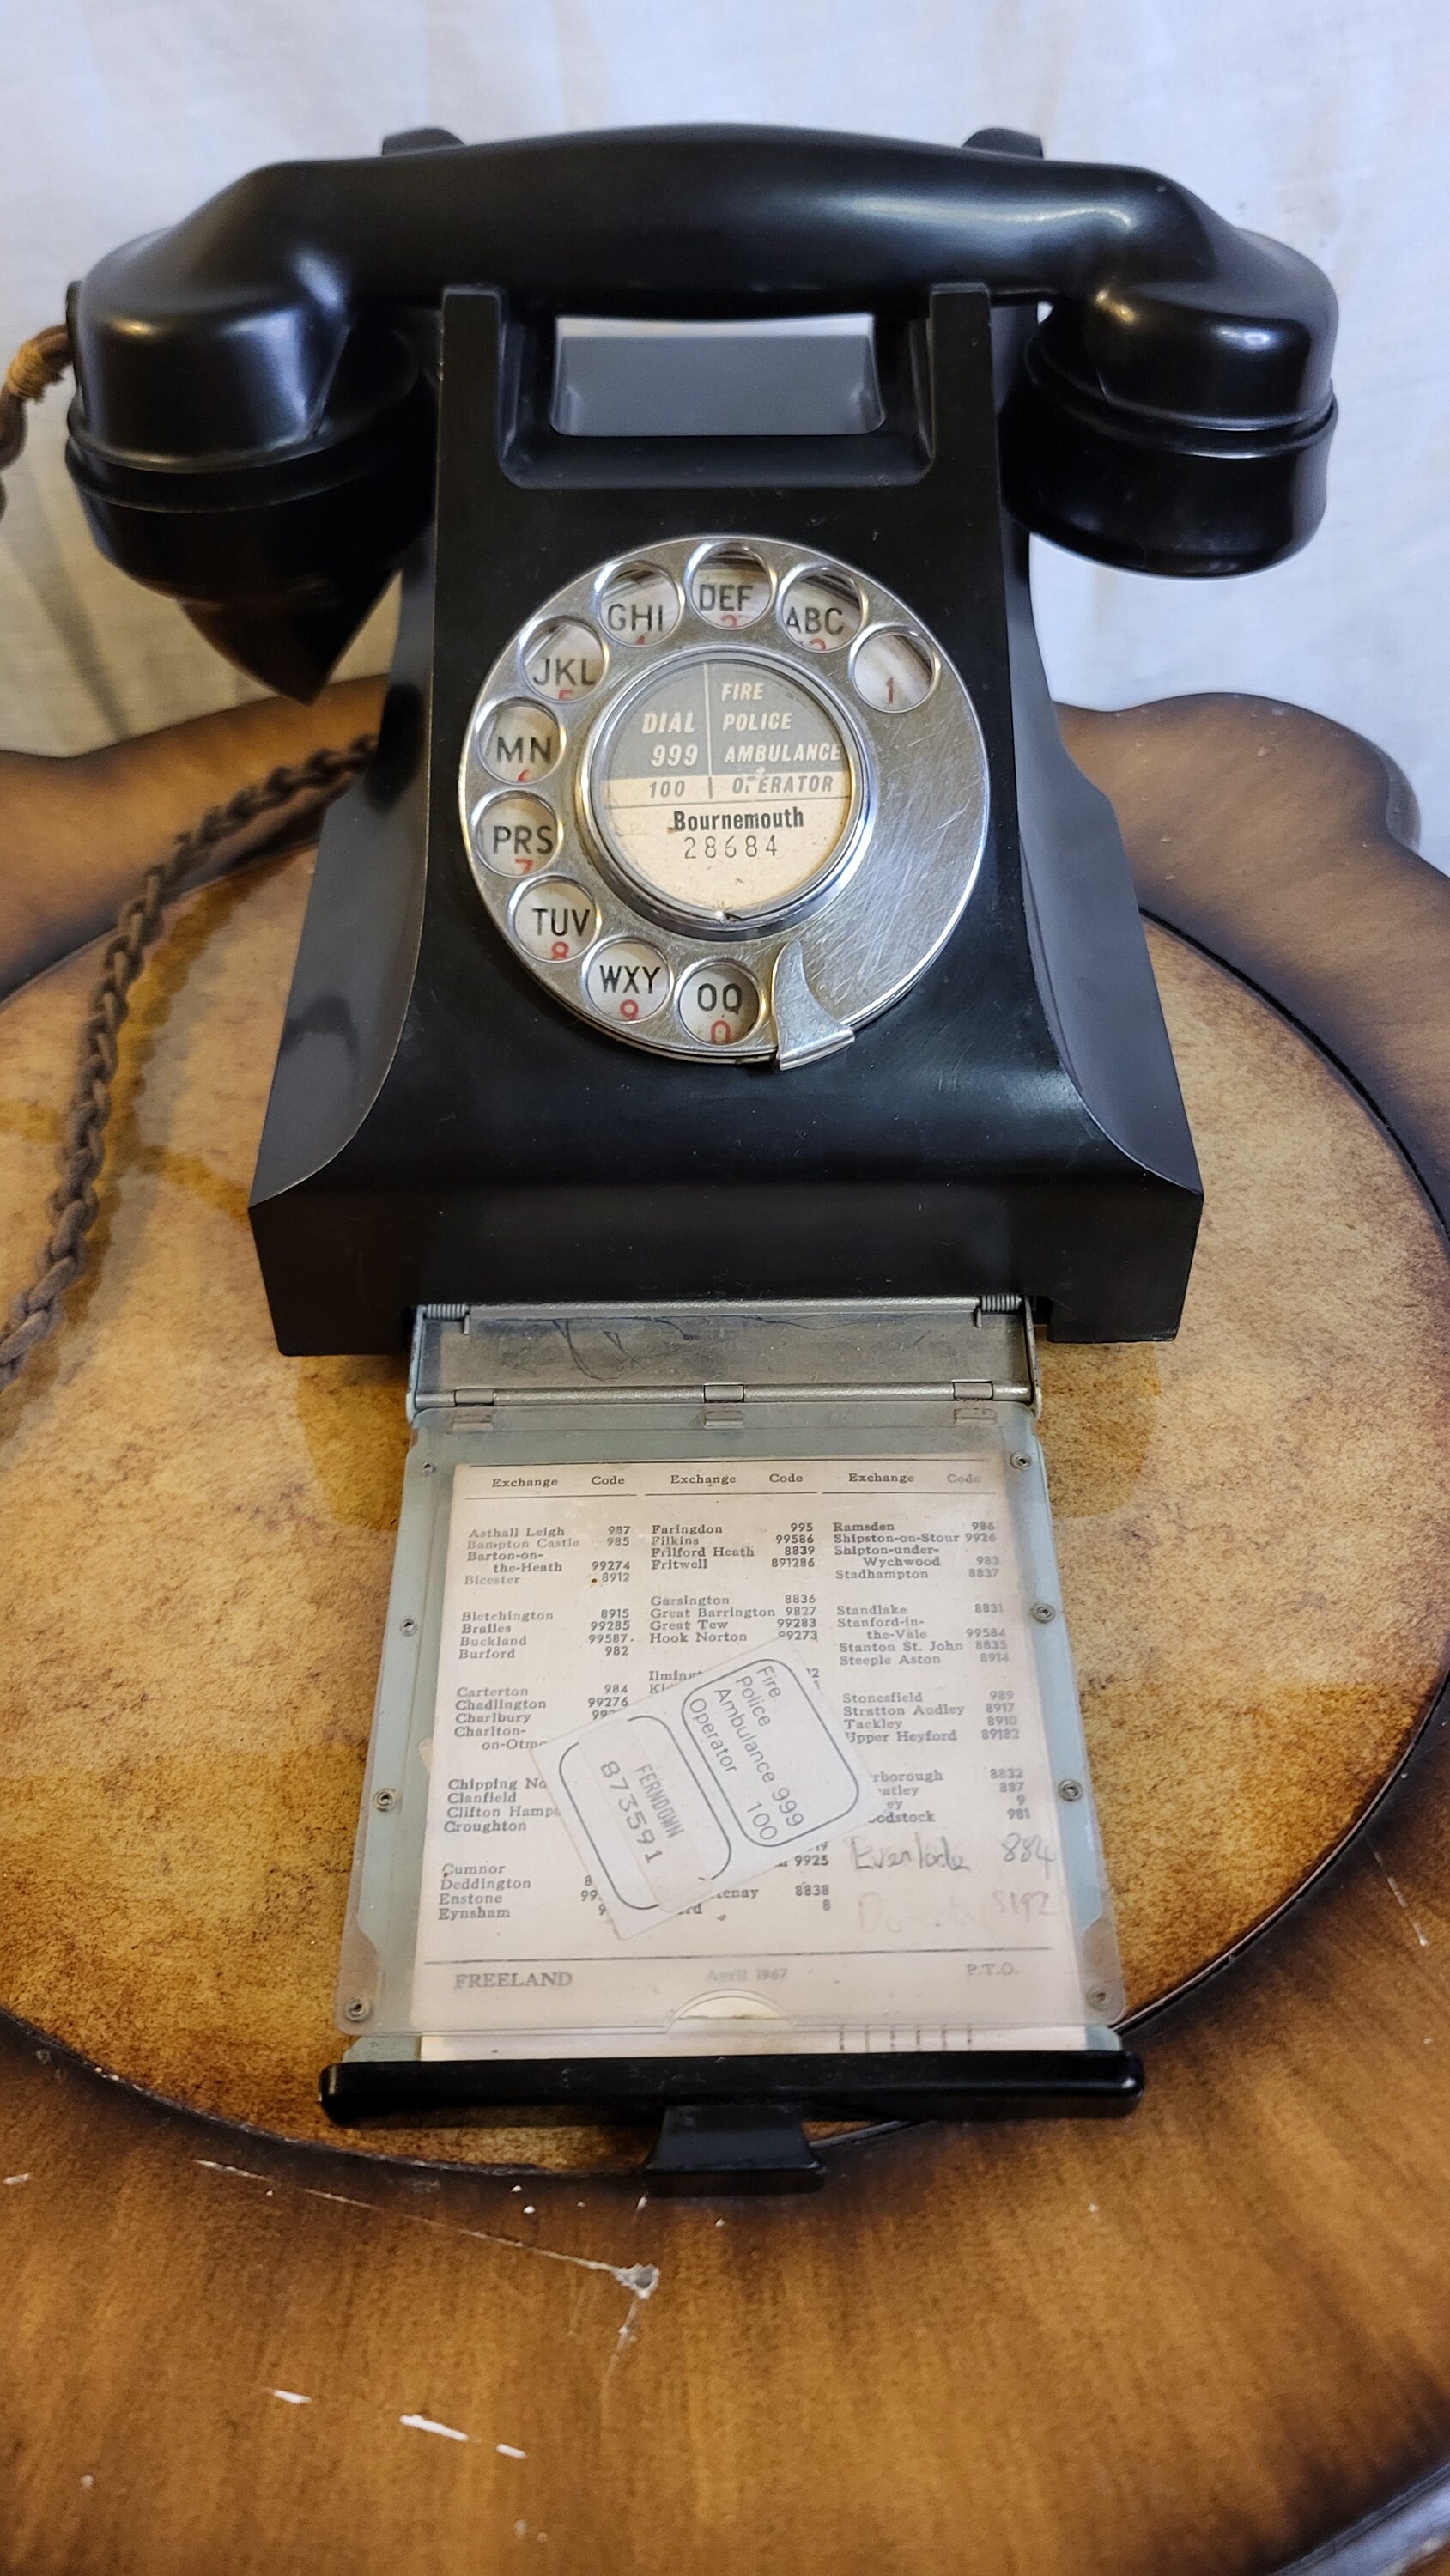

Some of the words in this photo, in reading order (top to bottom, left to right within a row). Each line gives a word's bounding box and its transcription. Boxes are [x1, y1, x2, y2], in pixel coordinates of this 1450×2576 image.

[699, 584, 754, 611] DEF
[607, 603, 664, 632] GHI
[785, 606, 845, 635] ABC
[533, 658, 597, 686] JKL
[721, 683, 764, 702] FIRE
[886, 677, 893, 704] 1
[642, 711, 695, 734] DIAL
[722, 712, 792, 732] POLICE
[496, 736, 552, 763] MN
[651, 744, 699, 767] 999
[724, 743, 841, 763] AMBULANCE
[650, 781, 686, 799] 100
[673, 806, 804, 832] Bournemouth
[493, 825, 554, 854] PRS
[683, 834, 779, 860] 28684
[532, 908, 591, 937] TUV
[600, 965, 661, 994] WXY
[492, 1478, 558, 1488] Exchange
[591, 1475, 625, 1485] Code
[670, 1475, 737, 1485] Exchange
[769, 1473, 804, 1483] Code
[848, 1473, 914, 1483] Exchange
[947, 1473, 980, 1484] Code
[469, 1528, 519, 1539] Asthall
[526, 1527, 565, 1537] Leigh
[608, 1526, 631, 1535] 987
[652, 1524, 723, 1535] Faringdon
[791, 1522, 814, 1532] 995
[833, 1522, 895, 1532] Ramsden
[972, 1522, 995, 1530] 986
[466, 1540, 530, 1550] Bampton
[537, 1539, 579, 1548] Castle
[607, 1537, 630, 1546] 985
[651, 1536, 700, 1546] Filkins
[775, 1534, 814, 1544] 99586
[834, 1533, 960, 1544] Shipston-on-Stour
[965, 1533, 996, 1542] 9926
[467, 1552, 543, 1561] Barton-on-
[651, 1547, 706, 1558] Frilford
[713, 1547, 755, 1558] Heath
[784, 1546, 815, 1556] 8839
[834, 1546, 939, 1556] Shipton-under-
[493, 1563, 563, 1573] the-Heath
[592, 1561, 630, 1571] 99274
[652, 1559, 707, 1571] Fritwell
[771, 1558, 816, 1568] 891286
[863, 1557, 941, 1568] Wychwood
[976, 1556, 1000, 1565] 983
[464, 1575, 520, 1585] Bicester
[601, 1573, 630, 1582] 8912
[835, 1570, 928, 1580] Stadhampton
[968, 1568, 998, 1577] 8837
[651, 1595, 729, 1607] Garsington
[785, 1595, 816, 1604] 8836
[461, 1611, 554, 1622] Bletchington
[601, 1609, 629, 1618] 8915
[650, 1608, 690, 1619] Great
[697, 1607, 776, 1618] Barrington
[786, 1607, 816, 1616] 9827
[836, 1605, 907, 1615] Standlake
[974, 1603, 1004, 1613] 8831
[461, 1624, 512, 1633] Brailes
[590, 1621, 630, 1631] 99285
[650, 1621, 691, 1631] Great
[698, 1620, 728, 1629] Tew
[777, 1619, 816, 1628] 99283
[838, 1617, 925, 1627] Stanford-in-
[649, 1633, 689, 1644] Hook
[695, 1631, 748, 1643] Norton
[866, 1630, 927, 1639] the-Vale
[966, 1628, 1005, 1638] 99584
[460, 1636, 527, 1647] Buckland
[839, 1643, 895, 1652] Stanton
[903, 1643, 922, 1651] St.
[929, 1641, 964, 1651] John
[975, 1641, 1007, 1650] 8835
[459, 1649, 515, 1660] Burford
[605, 1646, 628, 1656] 982
[840, 1656, 891, 1667] Steeple
[899, 1655, 941, 1665] Aston
[756, 1665, 781, 1698] Fire
[457, 1686, 528, 1698] Carterton
[604, 1685, 628, 1694] 984
[843, 1692, 923, 1704] Stonesfield
[990, 1690, 1014, 1700] 989
[455, 1699, 547, 1711] Chadlington
[587, 1697, 628, 1708] 99276
[735, 1675, 771, 1727] Police
[843, 1705, 905, 1716] Stratton
[913, 1704, 965, 1716] Audley
[986, 1703, 1015, 1713] 8917
[455, 1712, 531, 1724] Charlbury
[843, 1719, 903, 1730] Tackley
[987, 1716, 1017, 1726] 8910
[454, 1726, 526, 1738] Charlton-
[846, 1732, 889, 1744] Upper
[896, 1730, 957, 1743] Heyford
[981, 1728, 1020, 1740] 89182
[713, 1688, 775, 1783] Ambulance
[772, 1787, 804, 1827] 999
[689, 1698, 737, 1772] Operator
[747, 1801, 778, 1840] 100
[872, 1769, 943, 1783] rborough
[990, 1768, 1024, 1778] 8832
[448, 1778, 517, 1791] Chipping
[878, 1785, 919, 1796] atley
[999, 1782, 1024, 1793] 887
[447, 1792, 517, 1804] Clanfield
[634, 1764, 684, 1838] FERNDOWN
[1016, 1795, 1025, 1806] 9
[447, 1807, 500, 1818] Clifton
[1007, 1808, 1030, 1820] 981
[444, 1820, 526, 1834] Croughton
[794, 1855, 829, 1866] 9925
[442, 1863, 506, 1875] Cumnor
[440, 1878, 531, 1891] Deddington
[795, 1885, 829, 1896] 8838
[439, 1893, 502, 1905] Enstone
[822, 1899, 830, 1911] 8
[438, 1907, 510, 1921] Eynsham
[454, 1971, 573, 1990] FREELAND
